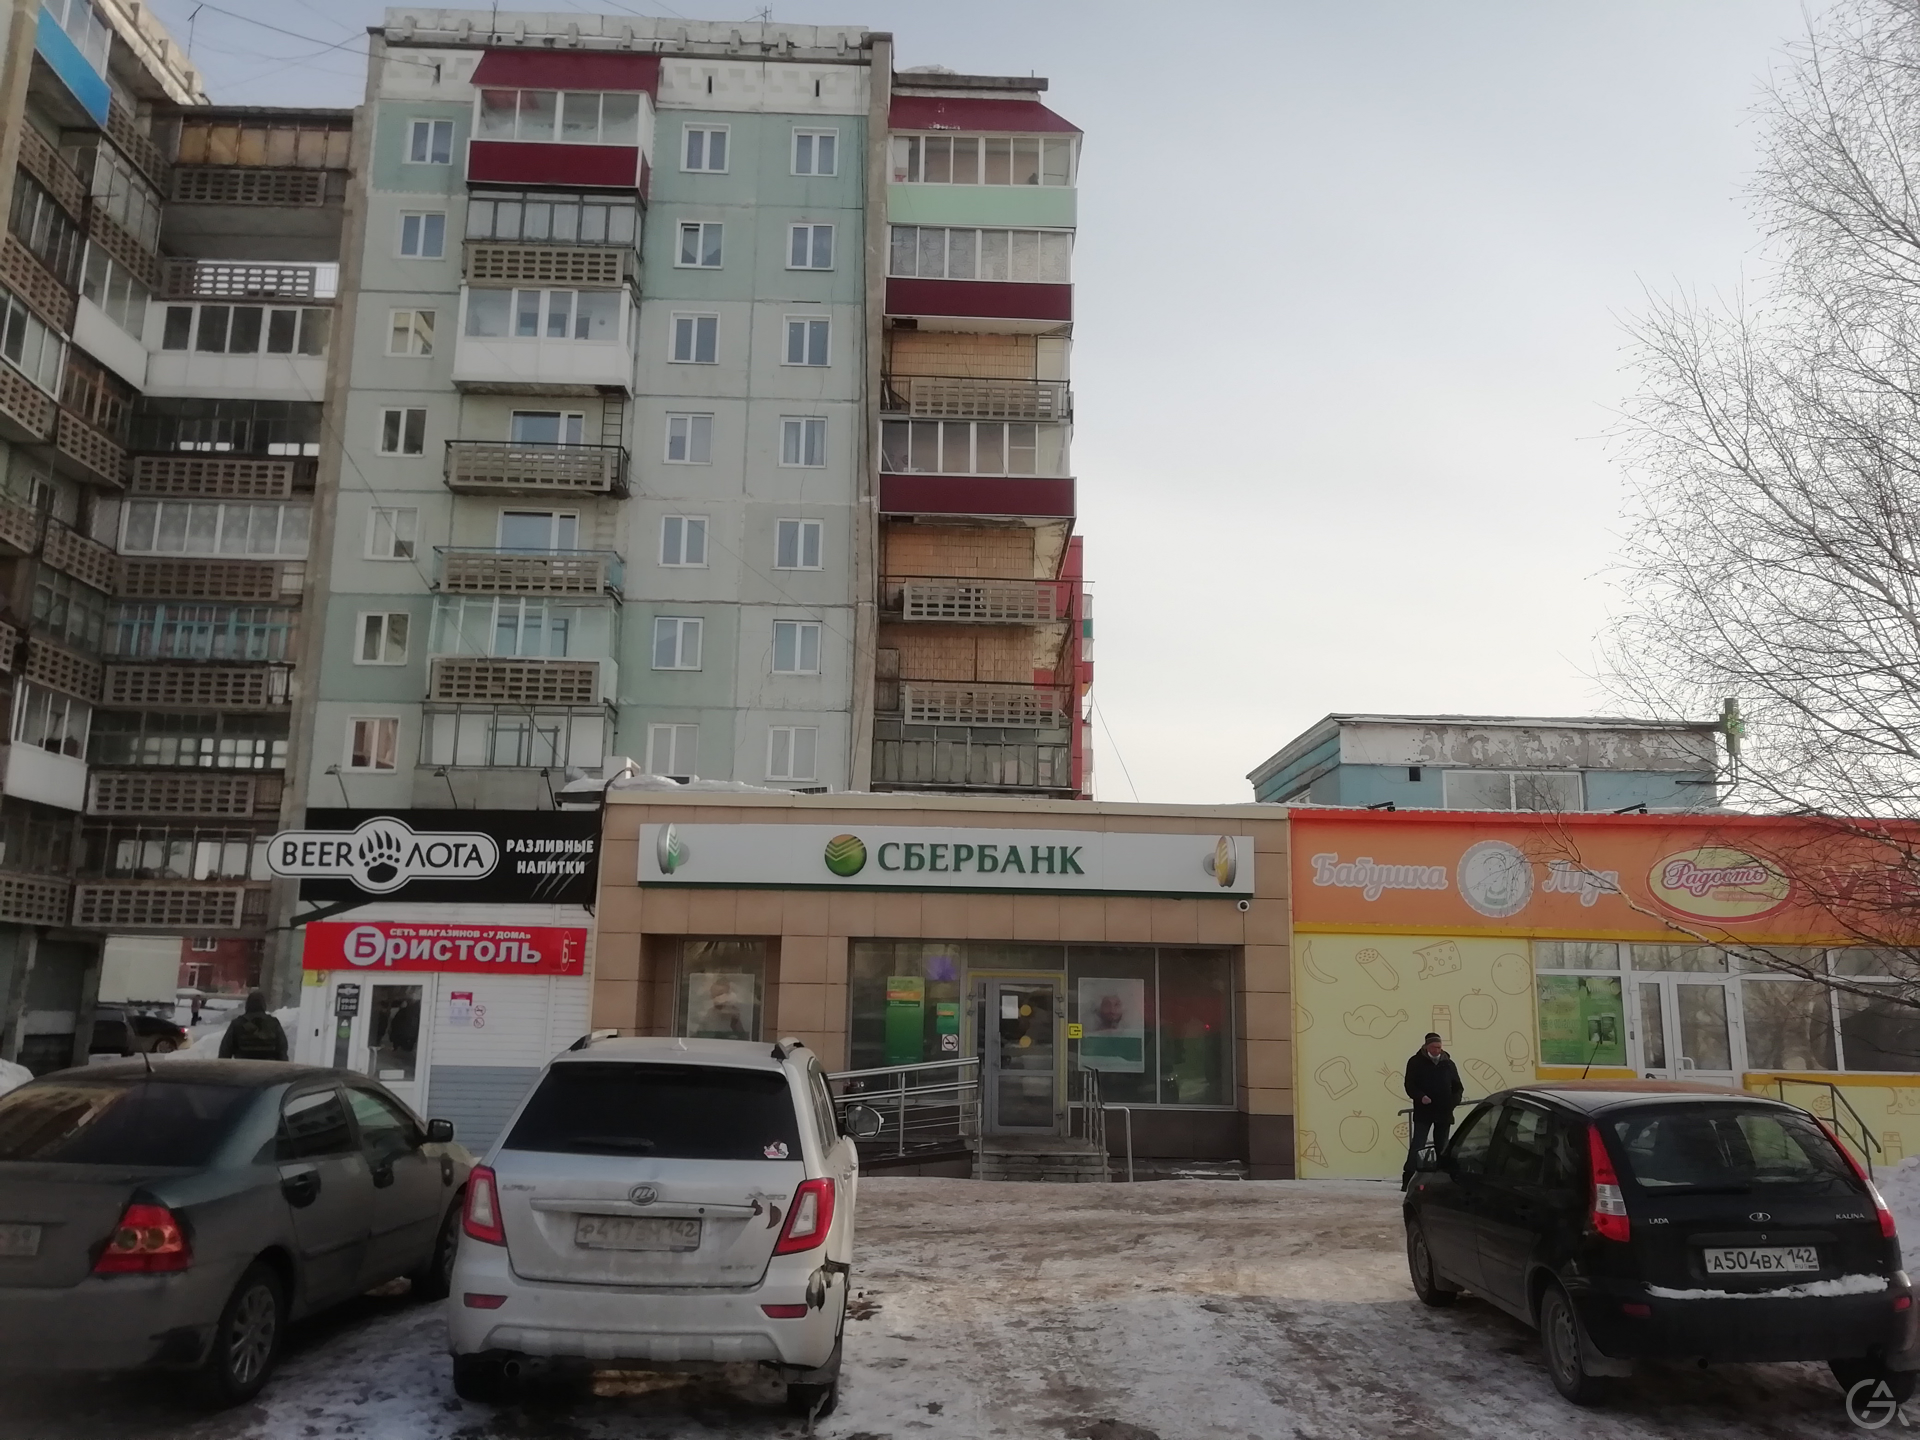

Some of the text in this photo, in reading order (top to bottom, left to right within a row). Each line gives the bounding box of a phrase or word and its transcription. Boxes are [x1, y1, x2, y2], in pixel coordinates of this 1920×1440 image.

[281, 841, 354, 867] BEER
[506, 839, 594, 853] РАЗЛИВНЫЕ
[517, 861, 585, 874] НАПИТКИ
[877, 842, 1086, 875] СБЕРБАНК
[1311, 852, 1448, 901] Бабушка
[1664, 860, 1767, 896] Радость
[390, 928, 416, 936] СЕТЬ
[419, 929, 480, 938] МАГАЗИНОВ
[350, 929, 542, 967] Бристоль
[1649, 1217, 1669, 1225] LADA
[1713, 1249, 1813, 1270] А504ВХ 142
